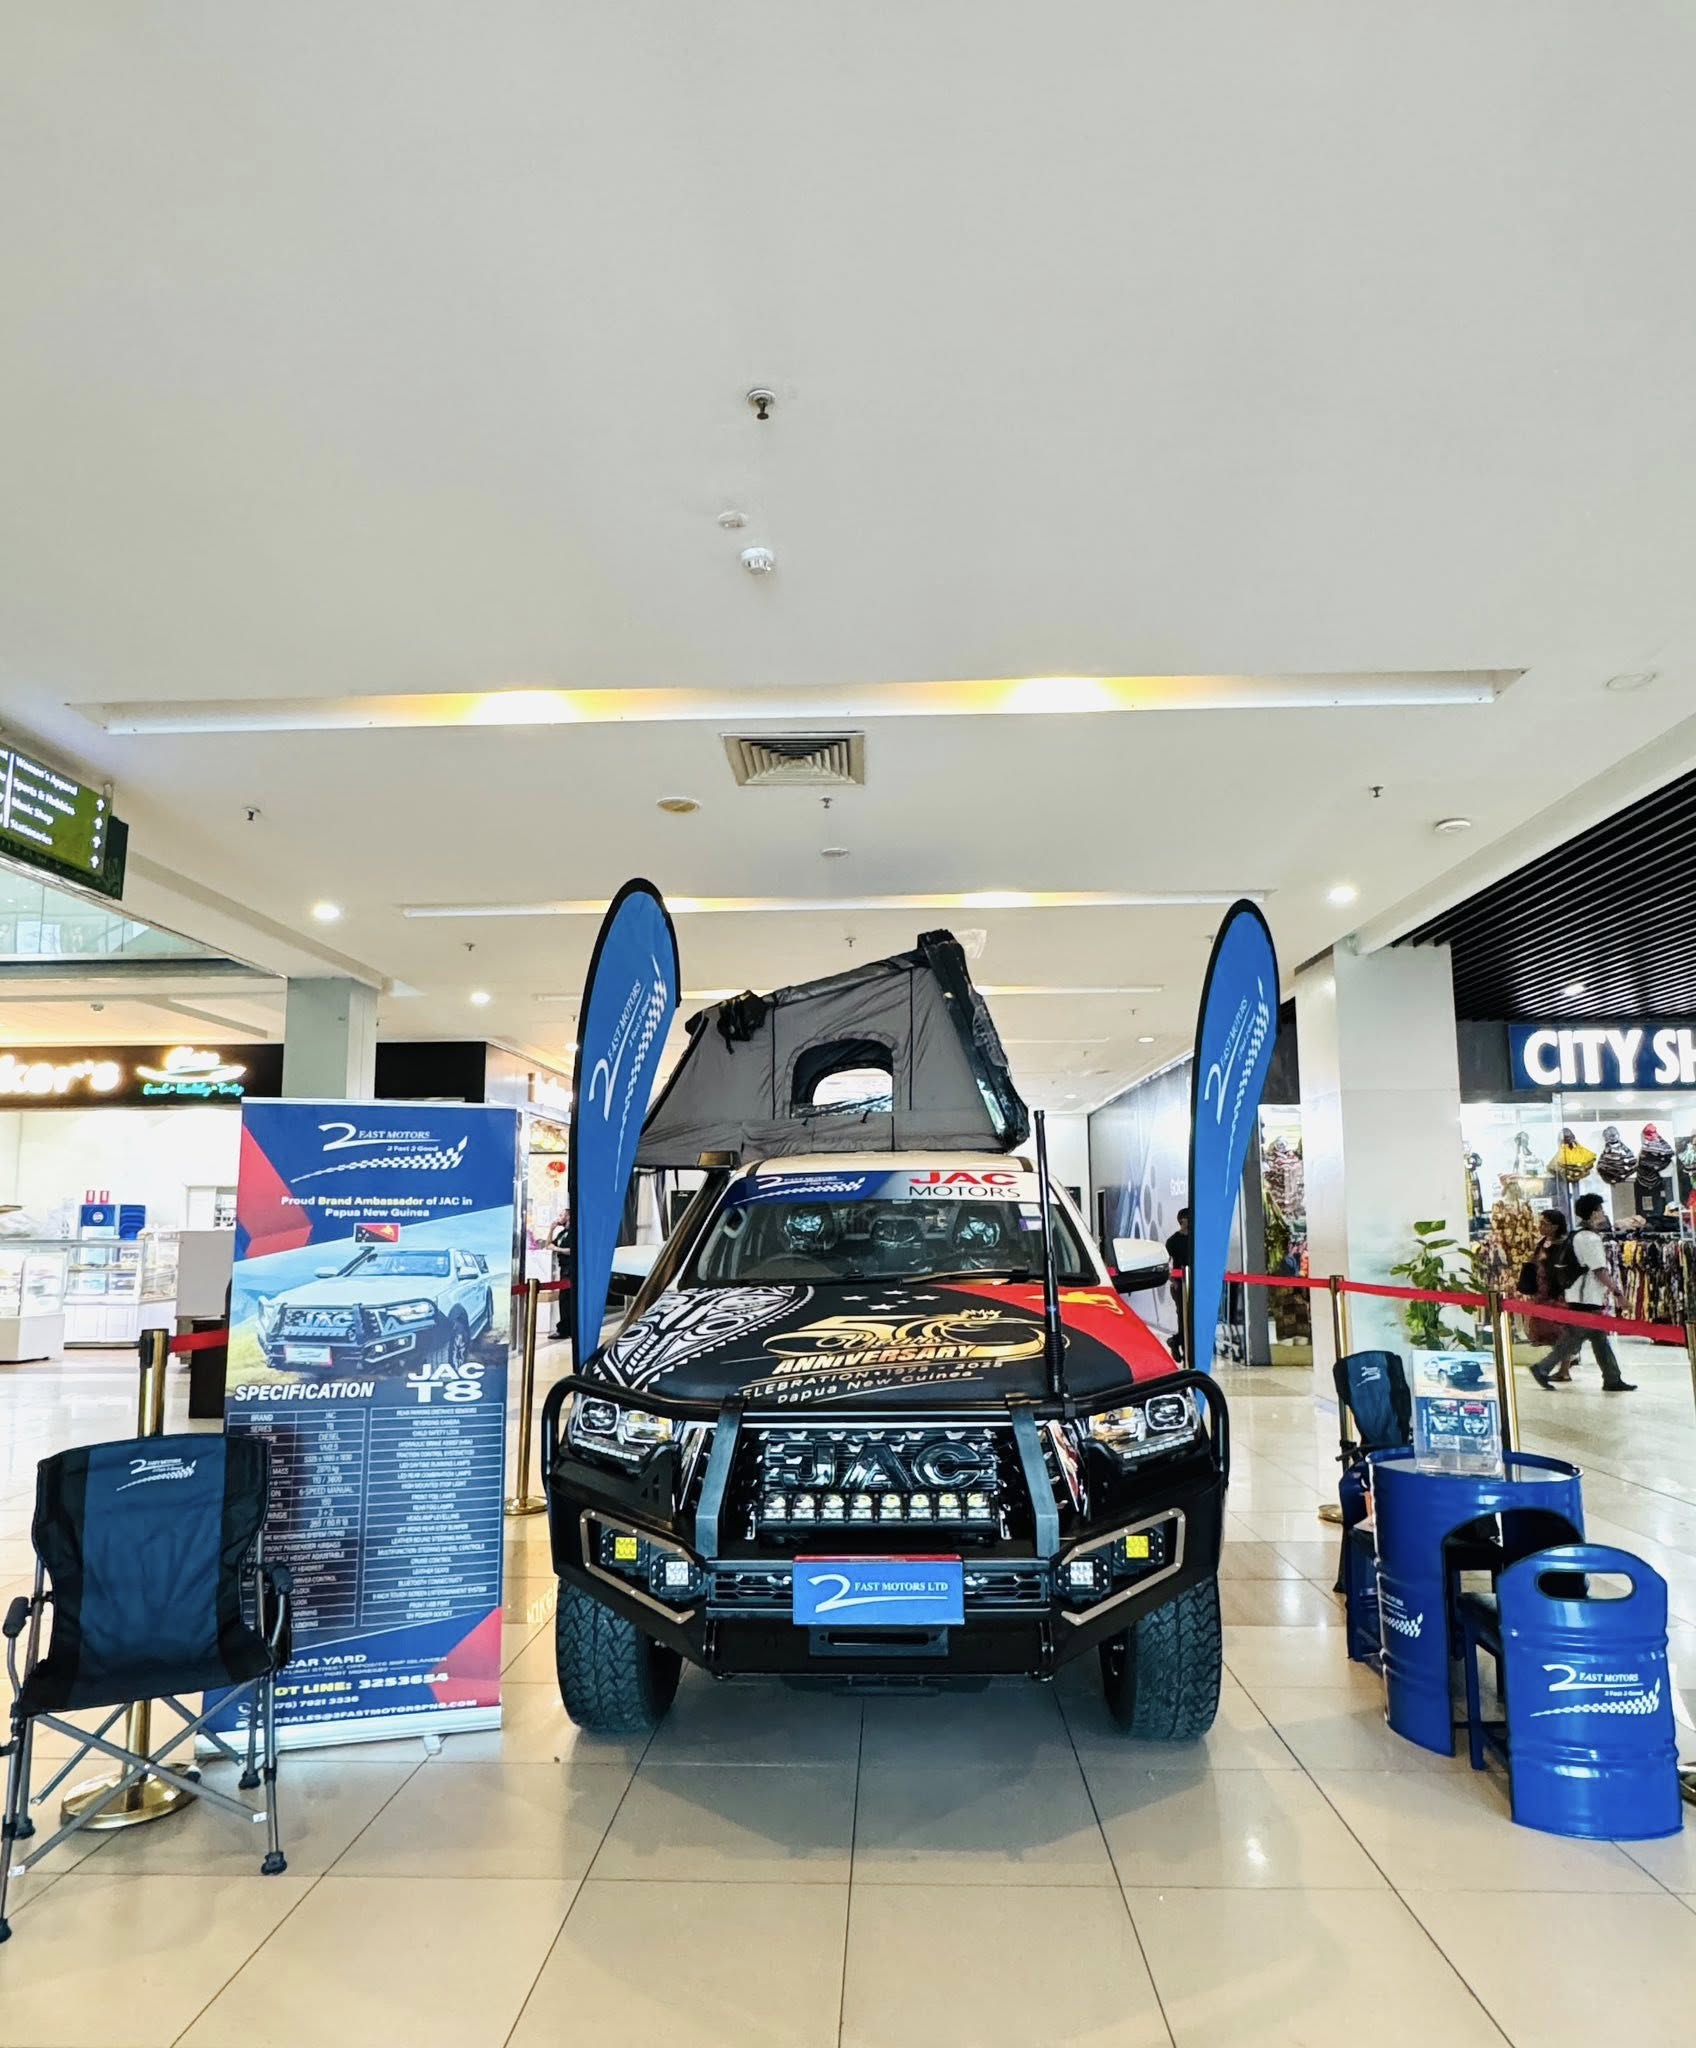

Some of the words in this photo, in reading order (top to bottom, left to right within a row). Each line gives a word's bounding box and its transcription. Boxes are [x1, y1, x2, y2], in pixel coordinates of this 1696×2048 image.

[1524, 1030, 1642, 1085] CITY
[318, 1122, 357, 1152] 2
[358, 1130, 386, 1139] FAST
[386, 1130, 430, 1140] MOTORS
[909, 1172, 1018, 1186] JAC
[281, 1196, 316, 1206] Proud
[318, 1196, 354, 1206] Brand
[356, 1196, 422, 1206] Ambassador
[426, 1196, 437, 1206] of
[438, 1196, 460, 1206] JAC
[462, 1196, 472, 1206] in
[908, 1185, 1020, 1198] MOTORS
[325, 1208, 360, 1218] Papua
[363, 1208, 388, 1216] New
[391, 1207, 430, 1216] Guinea
[407, 1362, 486, 1381] JAC
[772, 1345, 977, 1376] ANNIVERSARY
[406, 1380, 484, 1402] T8
[733, 1370, 868, 1400] ELEBRATION
[847, 1378, 892, 1390] New
[901, 1371, 974, 1383] Guinea
[234, 1382, 376, 1402] SPECIFICATION
[782, 1441, 980, 1489] JAC
[808, 1574, 850, 1613] 2
[854, 1582, 880, 1591] FAST
[882, 1582, 926, 1591] MOTORS
[928, 1582, 948, 1591] LTD
[322, 1654, 368, 1665] YARD
[302, 1681, 352, 1694] LINE:
[358, 1672, 449, 1689] 3253654
[1542, 1664, 1577, 1692] 2
[1580, 1672, 1602, 1682] FAST
[1604, 1673, 1638, 1682] MOTORS
[256, 1700, 478, 1726] CRSALES@2FASTMOTORSPNG.COM
